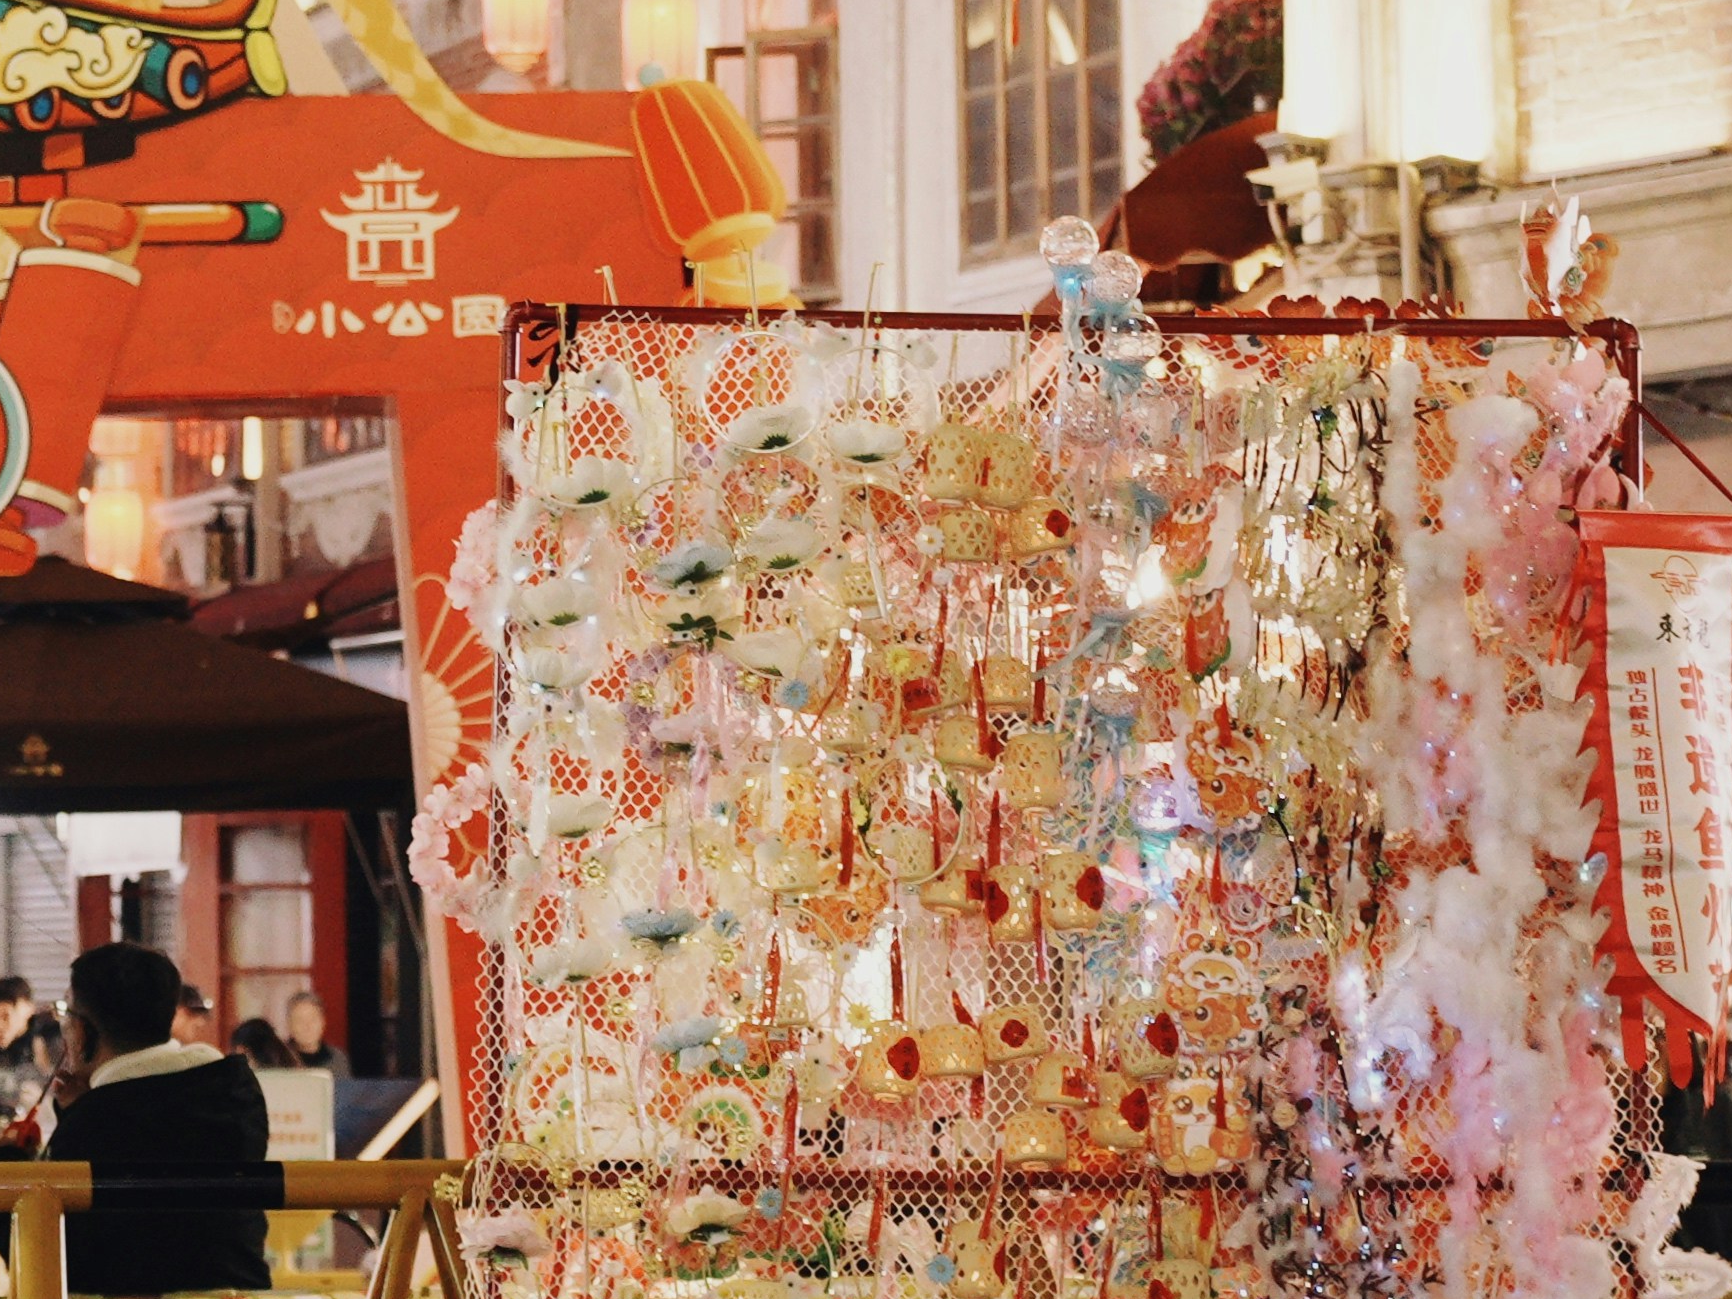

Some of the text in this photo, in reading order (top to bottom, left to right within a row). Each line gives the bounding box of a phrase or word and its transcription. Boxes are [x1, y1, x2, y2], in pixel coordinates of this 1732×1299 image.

[1633, 746, 1660, 814] 龙腾盛世
[1639, 829, 1666, 899] 龙马精神
[1647, 905, 1678, 975] 金榜题名
